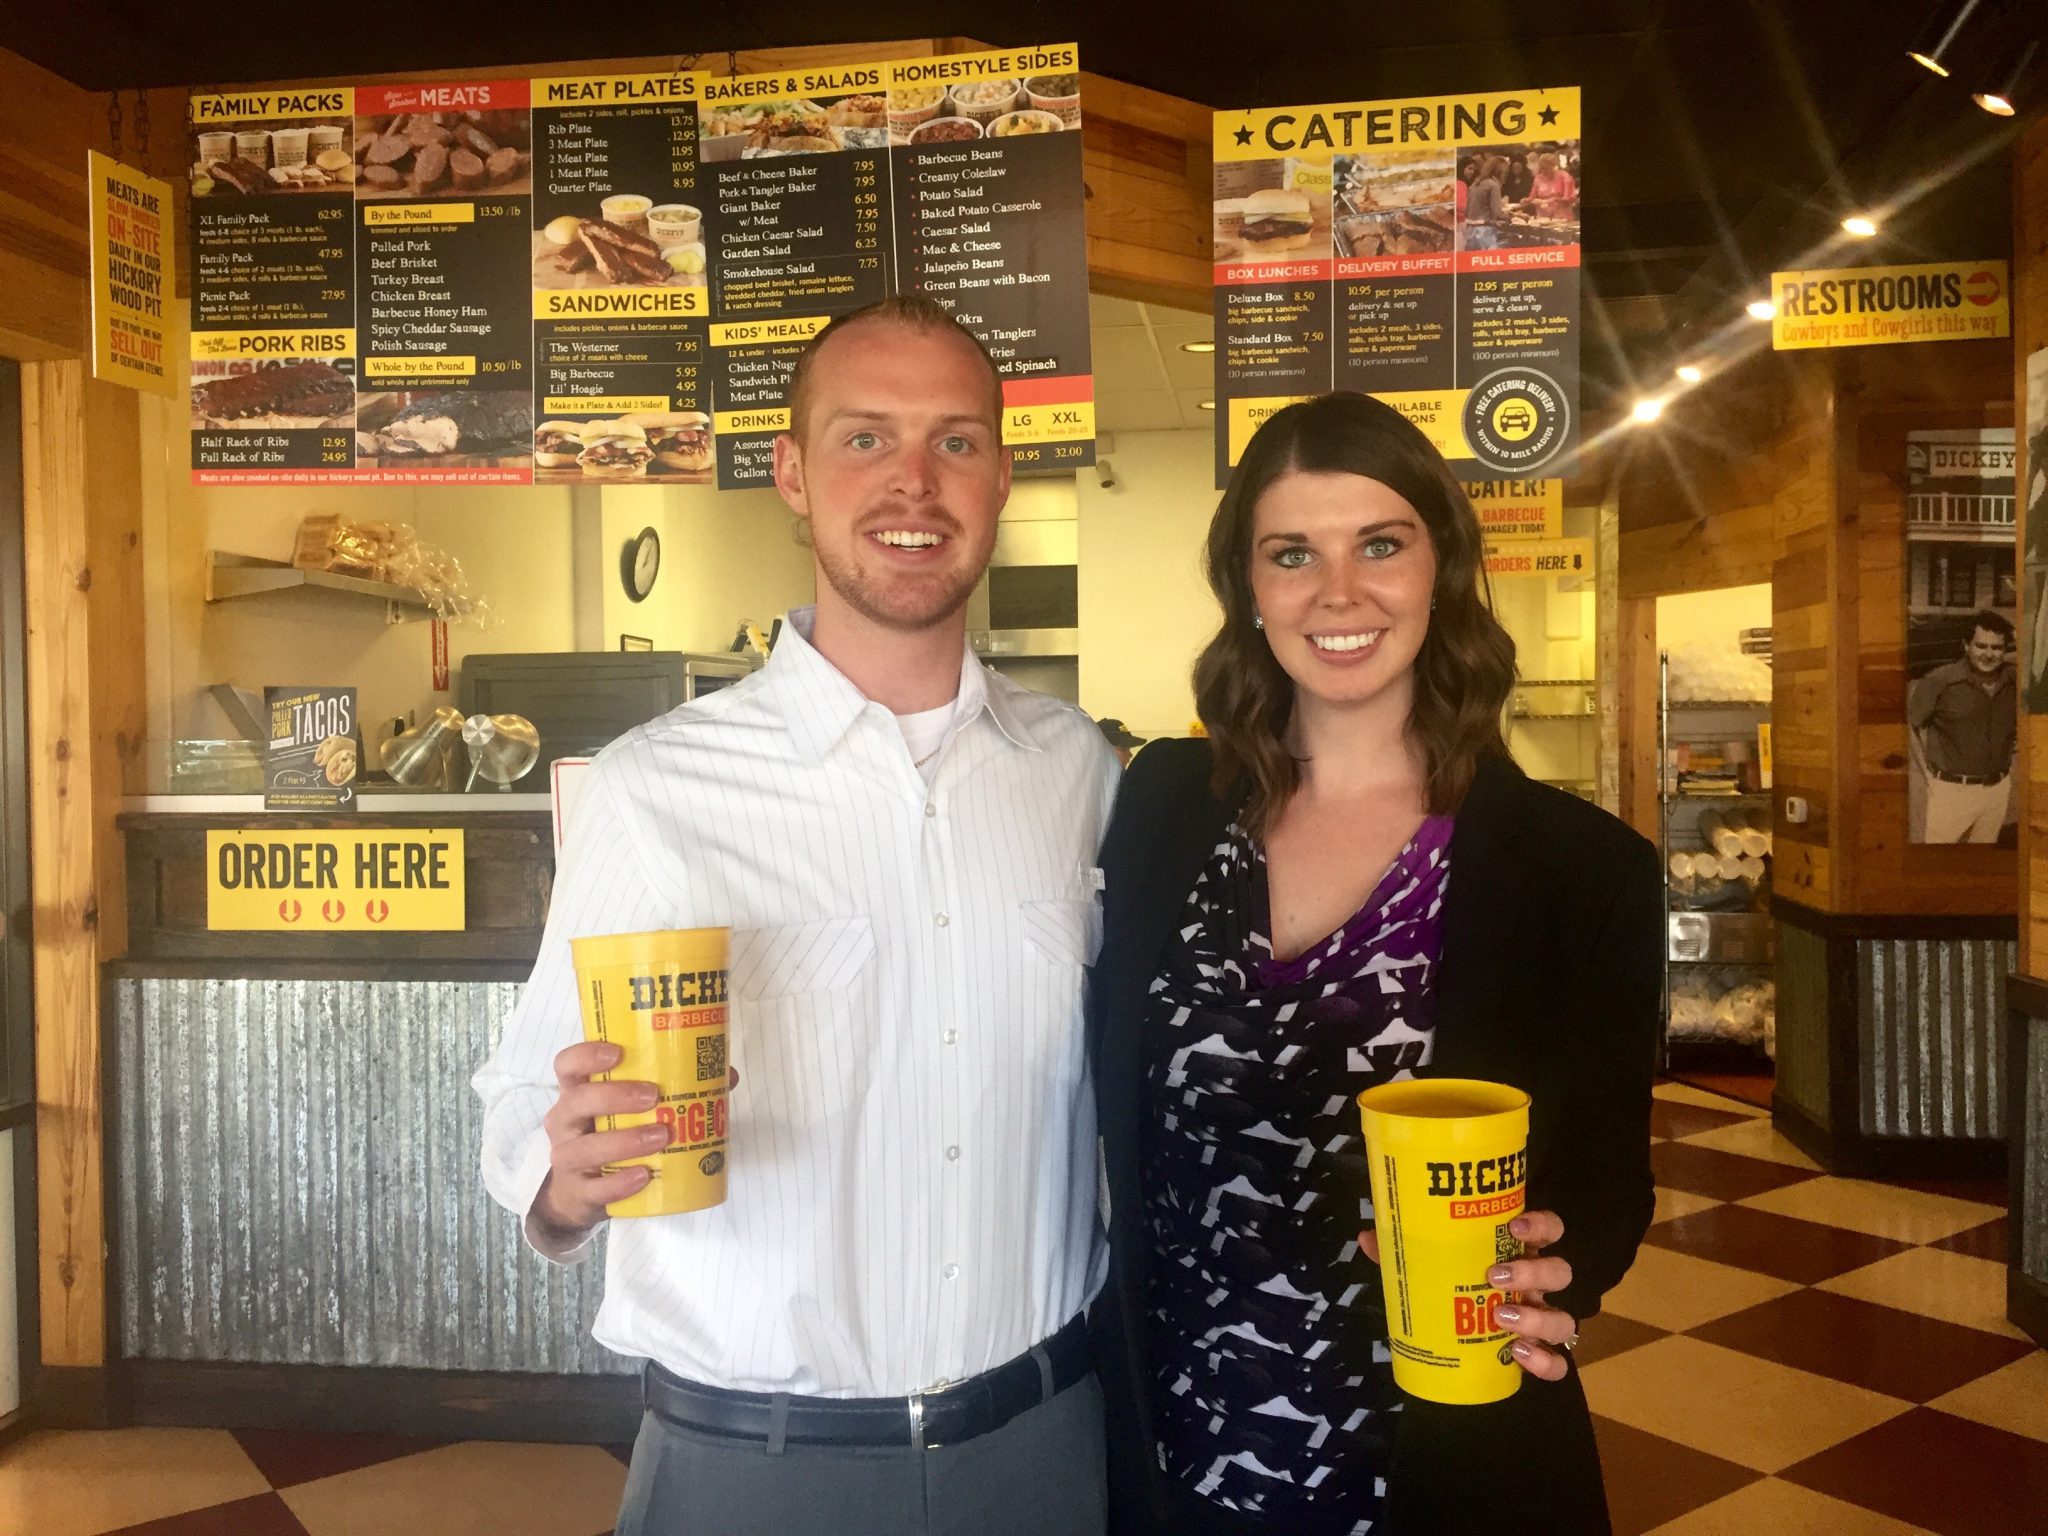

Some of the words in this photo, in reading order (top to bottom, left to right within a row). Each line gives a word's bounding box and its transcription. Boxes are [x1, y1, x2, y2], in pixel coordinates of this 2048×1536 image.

[893, 58, 1010, 82] HOMESTYLE
[1017, 51, 1073, 71] SIDES
[549, 82, 606, 100] MEAT
[614, 78, 695, 98] PLATES
[705, 79, 779, 100] BAKERS
[786, 78, 797, 92] &
[804, 70, 879, 90] SALADS
[421, 86, 490, 106] MEATS
[200, 94, 271, 117] FAMILY
[277, 94, 344, 114] PACKS
[1265, 101, 1527, 151] CATERING
[918, 154, 967, 165] Barbecue
[971, 150, 1003, 160] Beans
[919, 170, 959, 183] Creamy
[962, 168, 1006, 179] Coleslaw
[107, 177, 139, 206] MEATS
[142, 192, 160, 215] ARE
[920, 190, 950, 201] Potato
[954, 186, 983, 198] Salad
[720, 203, 748, 213] Giant
[751, 201, 781, 212] Baker
[855, 194, 876, 204] 6.50
[922, 207, 955, 219] Baked
[959, 206, 989, 216] Potato
[993, 200, 1042, 213] Casserole
[200, 216, 214, 225] XL
[217, 215, 246, 224] Family
[249, 214, 269, 223] Pack
[108, 214, 160, 256] ON-SITE
[722, 233, 759, 244] Chicken
[762, 231, 793, 240] Caesar
[797, 227, 823, 237] Salad
[856, 223, 876, 233] 7.50
[922, 226, 957, 237] Caesar
[961, 222, 991, 234] Salad
[371, 242, 404, 252] Pulled
[408, 241, 431, 251] Pork
[722, 248, 760, 259] Garden
[763, 245, 791, 256] Salad
[856, 238, 877, 248] 6.25
[923, 244, 946, 255] Mac
[950, 243, 960, 253] &
[964, 241, 1001, 252] Cheese
[108, 239, 131, 261] DAILY
[134, 250, 142, 266] IN
[145, 254, 160, 272] OUR
[371, 259, 397, 268] Beef
[401, 258, 437, 268] Brisket
[1472, 256, 1504, 266] FULL
[1508, 252, 1564, 264] SERVICE
[723, 266, 783, 279] Smokehouse
[787, 263, 815, 274] Salad
[859, 258, 878, 268] 7.75
[924, 261, 968, 274] Jalapeño
[972, 259, 1004, 270] Beans
[1228, 269, 1254, 279] BOX
[1259, 266, 1318, 277] LUNCHES
[1338, 261, 1399, 273] DELIVERY
[1402, 258, 1450, 270] BUFFET
[109, 257, 161, 296] HICKORY
[371, 275, 408, 286] Turkey
[412, 274, 444, 284] Breast
[924, 280, 956, 291] Green
[959, 278, 990, 288] Beans
[994, 275, 1015, 286] with
[1019, 273, 1050, 284] Bacon
[109, 282, 142, 311] WOOD
[371, 291, 414, 301] Chicken
[418, 291, 450, 300] Breast
[1228, 294, 1261, 303] Deluxe
[1265, 293, 1284, 301] Box
[1294, 292, 1315, 301] 8.50
[1375, 289, 1391, 298] per
[1394, 288, 1424, 297] person
[1782, 273, 1962, 316] RESTROOMS
[550, 293, 695, 313] SANDWICHES
[372, 308, 421, 317] Barbecue
[424, 307, 458, 317] Honey
[462, 306, 487, 316] Ham
[956, 315, 983, 324] Okra
[372, 325, 400, 336] Spicy
[403, 324, 446, 333] Cheddar
[450, 323, 491, 334] Sausage
[725, 327, 762, 339] KIDS'
[768, 323, 816, 337] MEALS
[992, 328, 1037, 340] Tanglers
[1782, 320, 1840, 344] Cowboys
[1844, 321, 1867, 338] and
[1872, 317, 1933, 339] Cowgirls
[1937, 315, 1966, 332] this
[1970, 314, 1997, 336] way
[110, 329, 137, 356] SELL
[141, 339, 162, 362] OUT
[240, 336, 295, 352] PORK
[302, 335, 345, 351] RIBS
[372, 341, 402, 350] Polish
[405, 340, 447, 352] Sausage
[1228, 334, 1271, 344] Standard
[1274, 334, 1292, 342] Box
[550, 343, 568, 352] The
[572, 342, 619, 352] Westerner
[676, 342, 697, 351] 7.95
[990, 348, 1015, 358] Fries
[1016, 359, 1057, 373] Spinach
[550, 370, 567, 380] Big
[570, 369, 614, 378] Barbecue
[676, 368, 697, 377] 5.95
[571, 385, 603, 395] Hoagie
[676, 382, 696, 391] 4.95
[731, 392, 756, 402] Meat
[759, 390, 783, 399] Plate
[1475, 395, 1491, 415] FREE
[1488, 380, 1526, 398] CATERING
[1527, 382, 1556, 412] DELIVERY
[732, 414, 785, 428] DRINKS
[1014, 415, 1032, 427] LG
[1053, 412, 1081, 424] XXL
[202, 437, 223, 447] Half
[227, 437, 250, 447] Rack
[254, 437, 264, 446] of
[268, 437, 289, 447] Ribs
[323, 438, 346, 447] 12.95
[1477, 429, 1500, 454] WITHIN
[1501, 450, 1509, 458] 10
[1511, 450, 1531, 459] MILE
[1531, 426, 1554, 453] RADIUS
[1014, 451, 1040, 461] 10.95
[1055, 447, 1082, 458] 32.00
[1467, 480, 1545, 498] CATER!
[1483, 507, 1545, 522] BARBECUE
[1536, 556, 1568, 570] HERE
[272, 702, 285, 710] TRY
[286, 697, 301, 706] OUR
[303, 693, 320, 703] NEW
[294, 695, 350, 745] TACOS
[219, 843, 338, 889] ORDER
[355, 843, 450, 888] HERE
